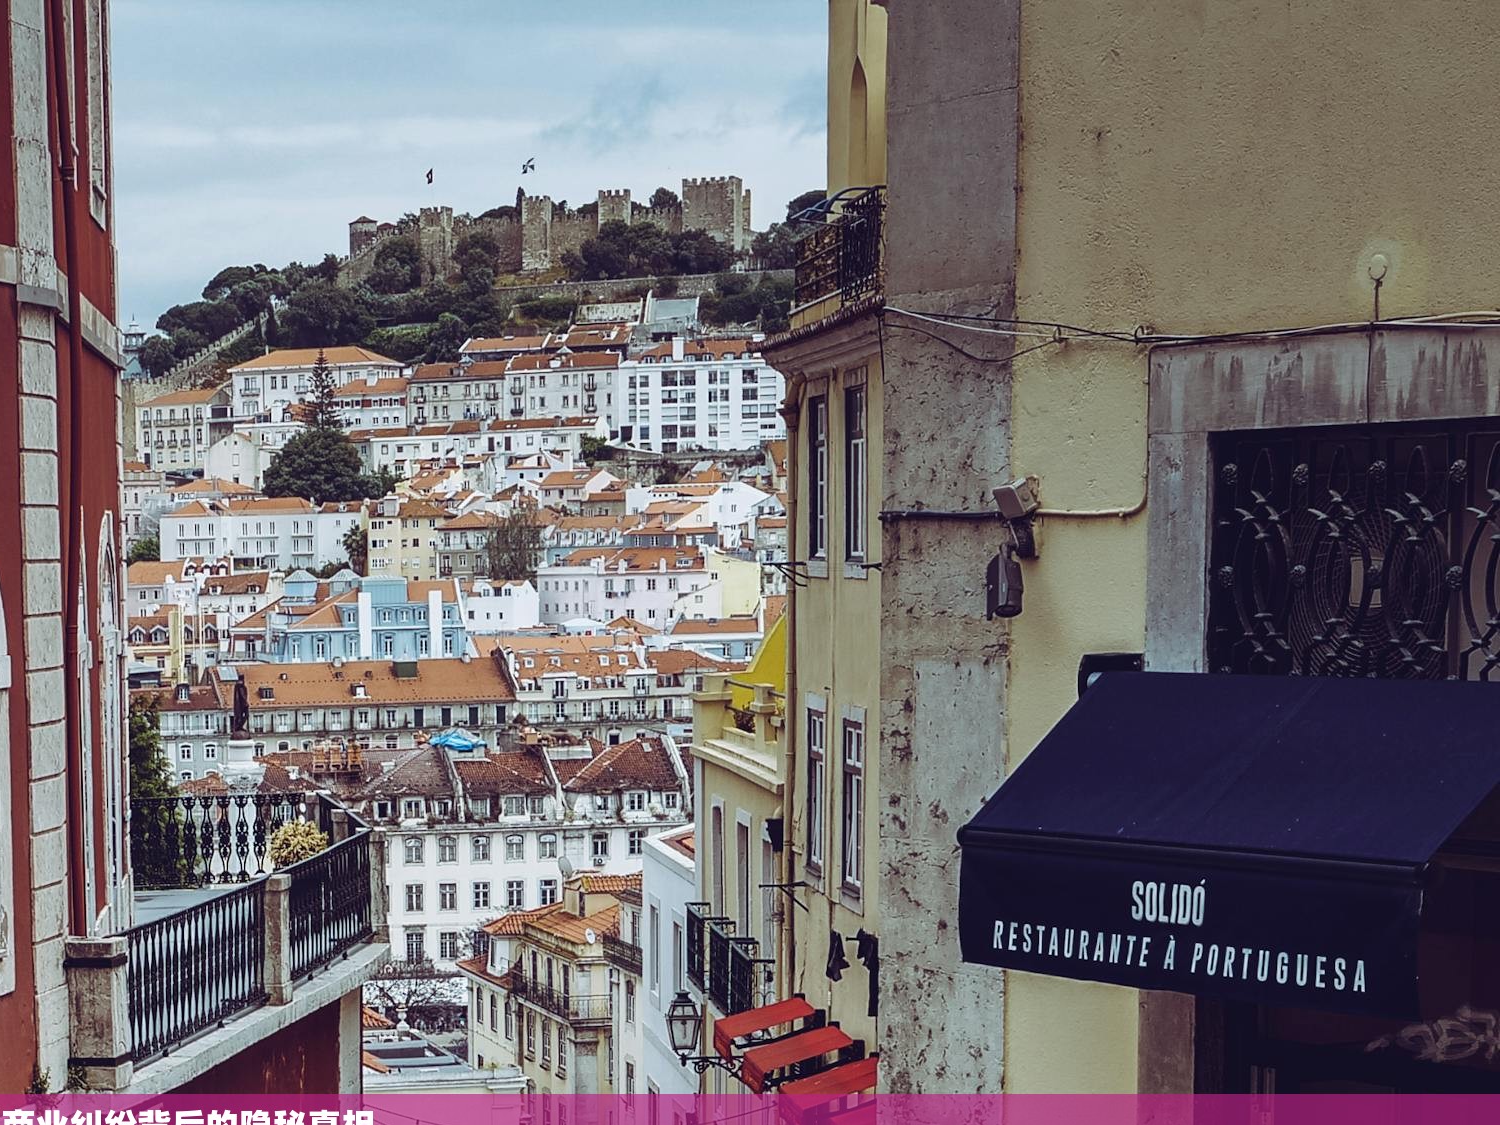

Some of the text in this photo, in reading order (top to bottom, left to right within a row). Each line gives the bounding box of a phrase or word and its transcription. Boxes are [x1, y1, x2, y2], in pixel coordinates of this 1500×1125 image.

[1131, 879, 1206, 926] SOLIDÓ
[993, 920, 1366, 993] RESTAURANTE À PORTUGUESA
